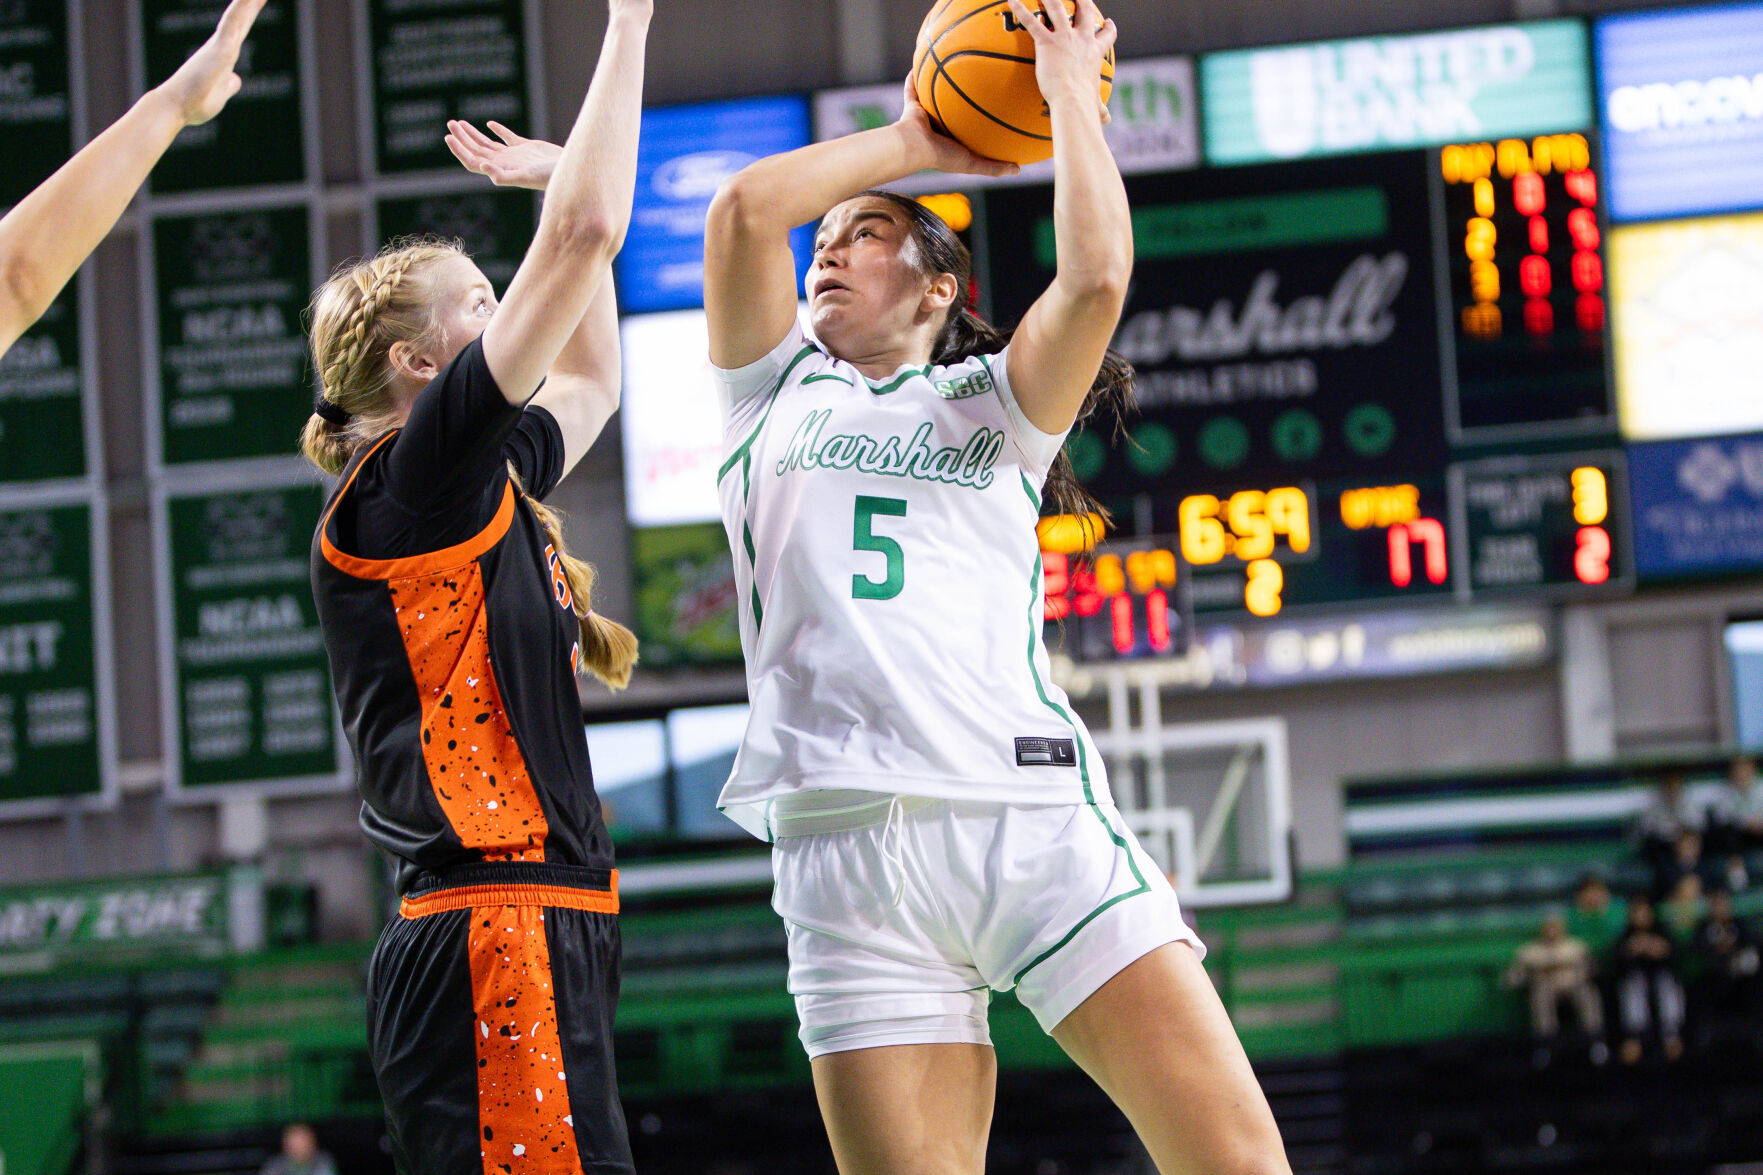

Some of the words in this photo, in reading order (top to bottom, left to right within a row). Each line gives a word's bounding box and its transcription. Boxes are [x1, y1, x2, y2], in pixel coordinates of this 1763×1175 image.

[1113, 250, 1408, 364] arshall
[934, 370, 992, 399] SBC
[776, 408, 1005, 490] Marshall
[852, 494, 907, 600] 5
[1179, 486, 1310, 565] 6:59
[1575, 526, 1611, 584] 2
[1245, 559, 1283, 616] 2
[1058, 746, 1067, 758] L
